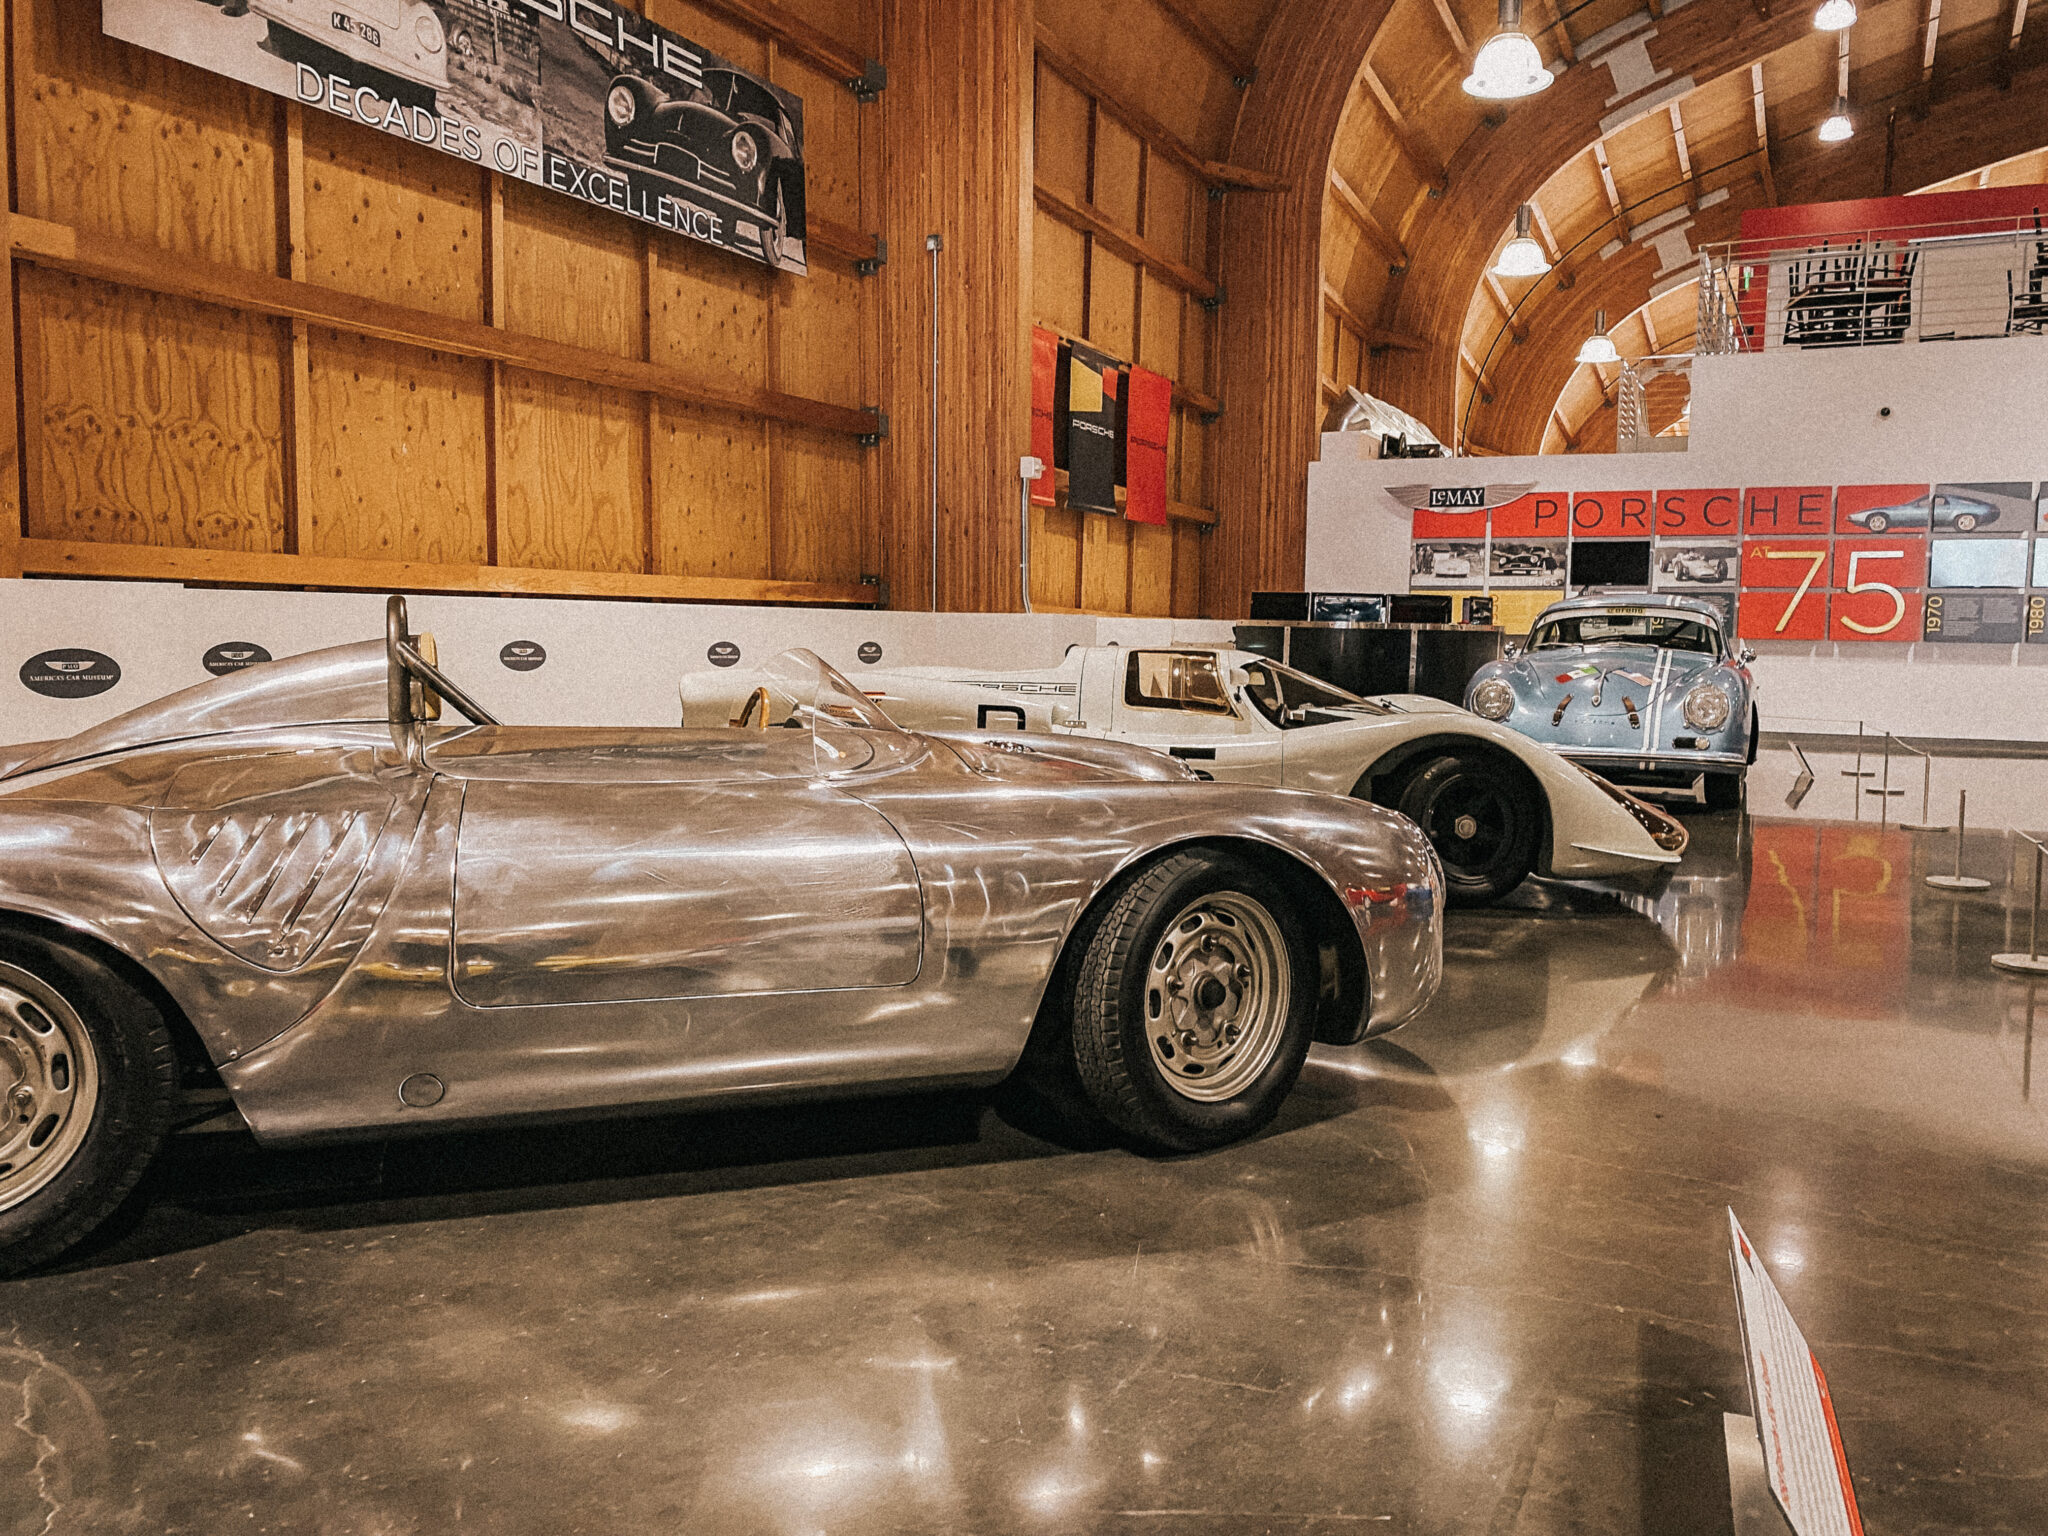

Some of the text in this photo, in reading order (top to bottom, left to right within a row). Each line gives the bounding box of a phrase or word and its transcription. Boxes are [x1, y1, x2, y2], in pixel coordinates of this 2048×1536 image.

[360, 23, 379, 45] 286
[296, 62, 724, 246] DECADES OF EXCELLENCE
[1072, 418, 1115, 440] PORSCHE
[1535, 493, 1825, 529] PORSCHE
[1750, 545, 1770, 559] AT
[1767, 550, 1905, 634] 75
[1926, 596, 1943, 634] 1970
[2028, 596, 2046, 636] 1980
